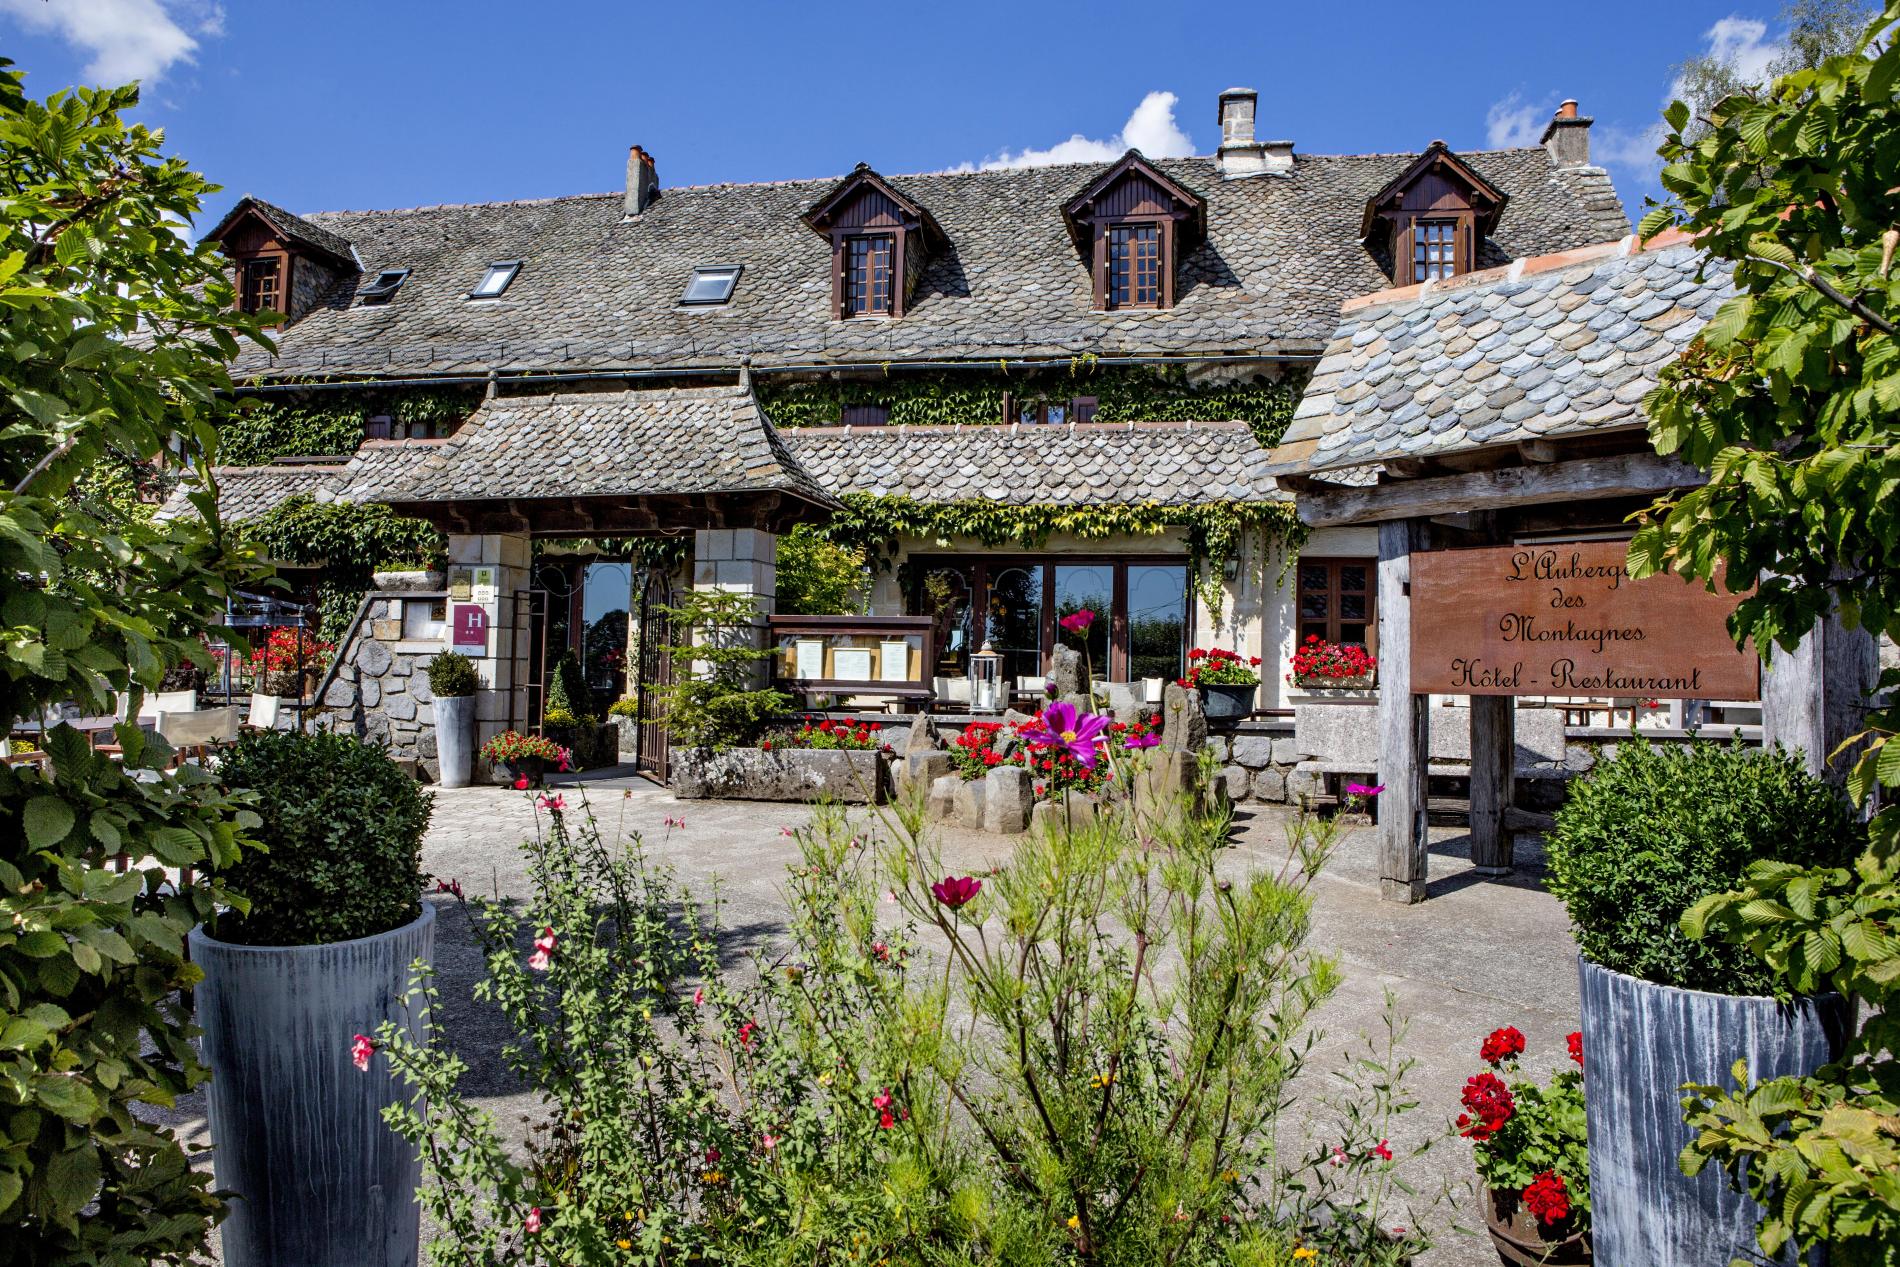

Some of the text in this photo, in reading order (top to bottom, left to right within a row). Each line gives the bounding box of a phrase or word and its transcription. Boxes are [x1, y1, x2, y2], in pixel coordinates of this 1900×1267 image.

[1550, 587, 1587, 609] des
[468, 612, 482, 628] H
[1499, 613, 1647, 653] Montagnes
[1451, 658, 1523, 688] Hôtel
[1550, 658, 1702, 691] Restaurant
